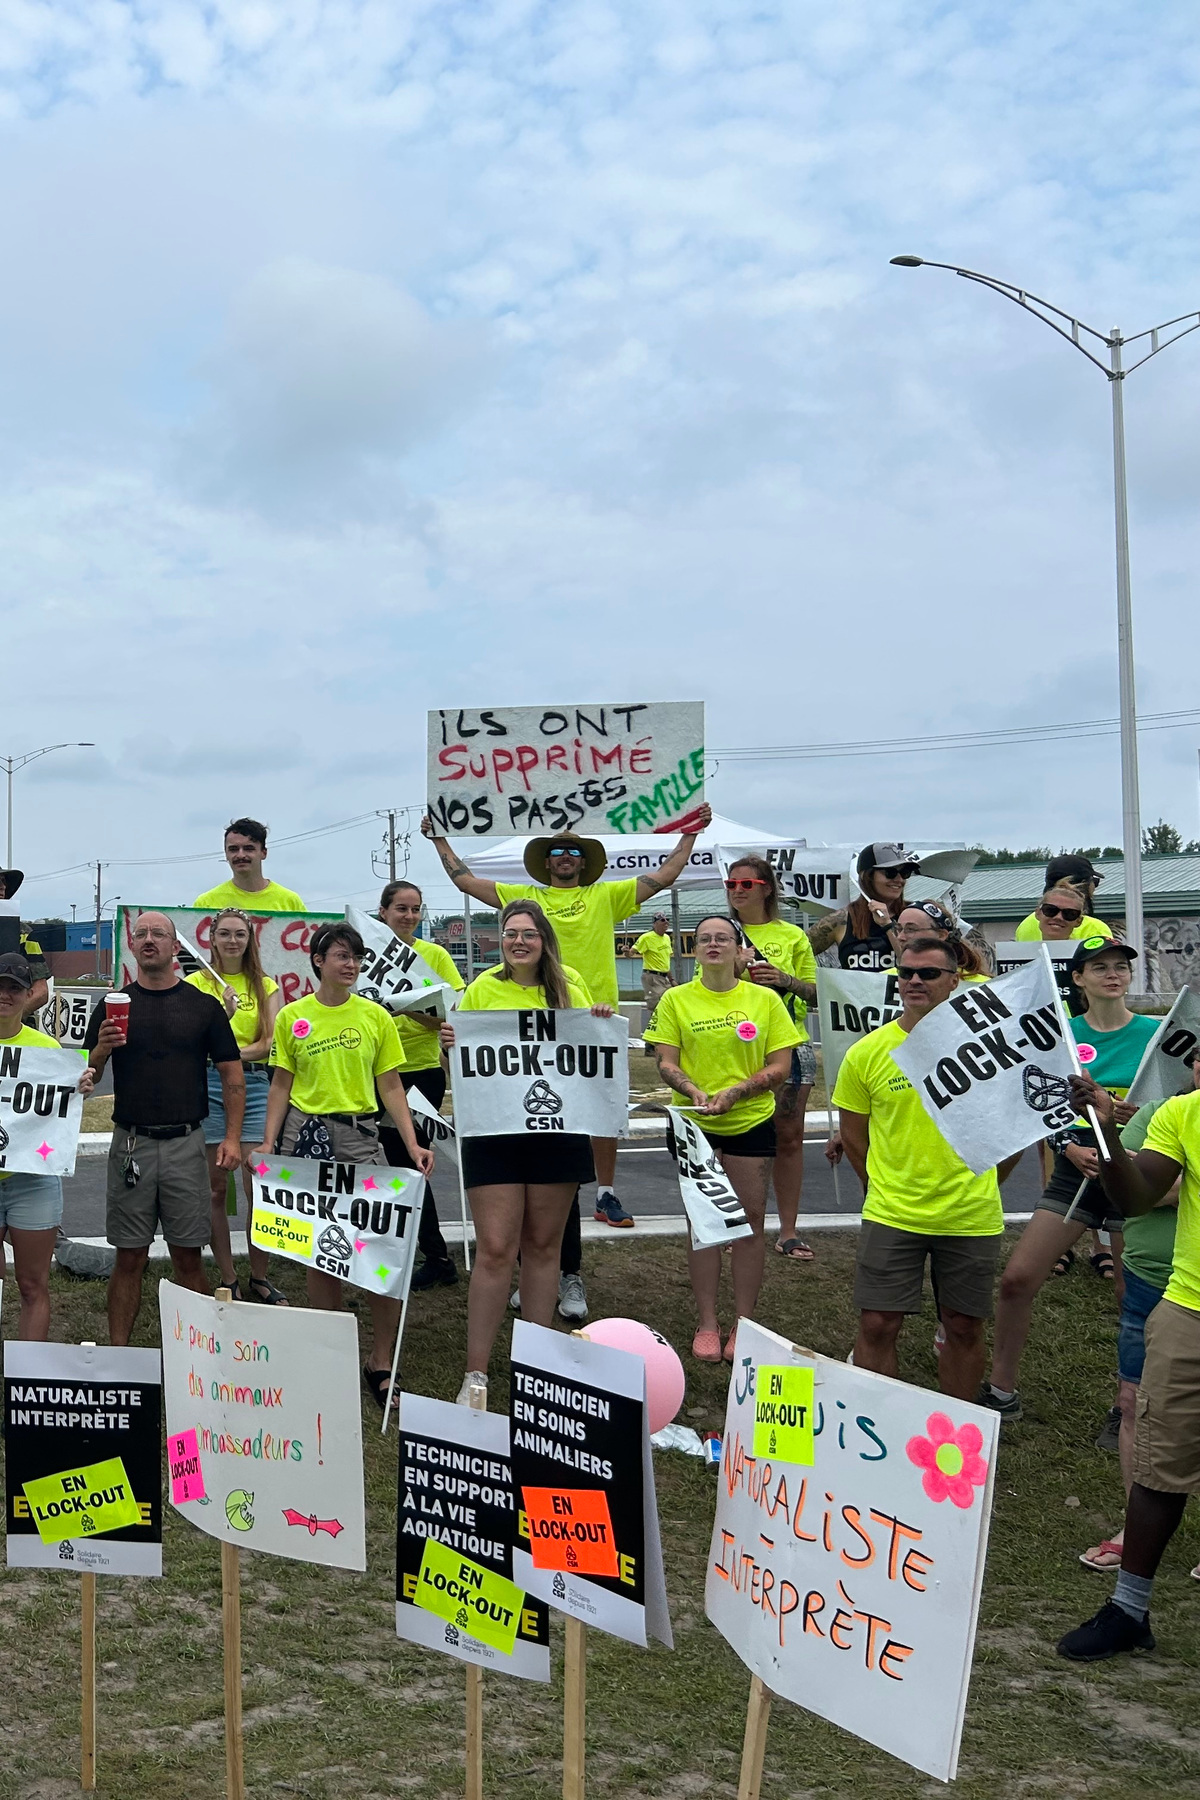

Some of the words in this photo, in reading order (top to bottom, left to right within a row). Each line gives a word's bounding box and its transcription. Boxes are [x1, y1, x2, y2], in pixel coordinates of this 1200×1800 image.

[539, 704, 648, 736] ONT
[427, 795, 493, 837] NOS
[766, 849, 796, 871] EN
[450, 924, 464, 935] IGA
[382, 936, 417, 974] EN
[847, 950, 897, 969] adid
[884, 975, 901, 1006] E
[71, 998, 87, 1040] CSN
[949, 984, 1013, 1034] EN
[518, 1010, 557, 1041] EN
[460, 1044, 618, 1078] LOCK-OUT
[525, 1117, 564, 1130] CSN
[1042, 1106, 1082, 1130] CS
[675, 1134, 690, 1178] EN
[318, 1162, 356, 1195] EN
[261, 1185, 412, 1239] LOCK-OUT
[275, 1217, 290, 1227] EN
[255, 1222, 309, 1244] LOCK-OUT
[315, 1254, 350, 1278] CSN
[174, 1309, 184, 1342] Je
[189, 1324, 221, 1355] prends
[10, 1386, 142, 1406] NATURALISTE
[211, 1381, 284, 1408] animaux
[514, 1372, 610, 1422] TECHNICIEN
[770, 1374, 783, 1396] EN
[11, 1408, 130, 1429] INTERPRÈTE
[513, 1400, 535, 1424] EN
[538, 1408, 586, 1441] SOINS
[755, 1401, 808, 1429] LOCK-OUT
[177, 1440, 187, 1457] EN
[404, 1440, 513, 1484] TECHNICIEN
[513, 1428, 613, 1480] ANIMALIERS
[60, 1474, 87, 1494] EN
[170, 1460, 199, 1480] LOCK-OUT
[404, 1466, 428, 1488] EN
[35, 1485, 125, 1521] LOCK-OUT
[402, 1486, 416, 1510] À
[420, 1497, 444, 1518] LA
[447, 1502, 477, 1527] VIE
[552, 1495, 574, 1516] EN
[402, 1517, 505, 1561] AQUATIQUE
[530, 1518, 607, 1545] LOCK-OUT
[458, 1562, 484, 1590] EN
[422, 1567, 514, 1627] LOCK-OUT
[552, 1588, 565, 1600] CSN
[714, 1527, 914, 1682] INTERPRÈTE
[455, 1618, 468, 1629] CSN
[444, 1636, 460, 1647] CSN
